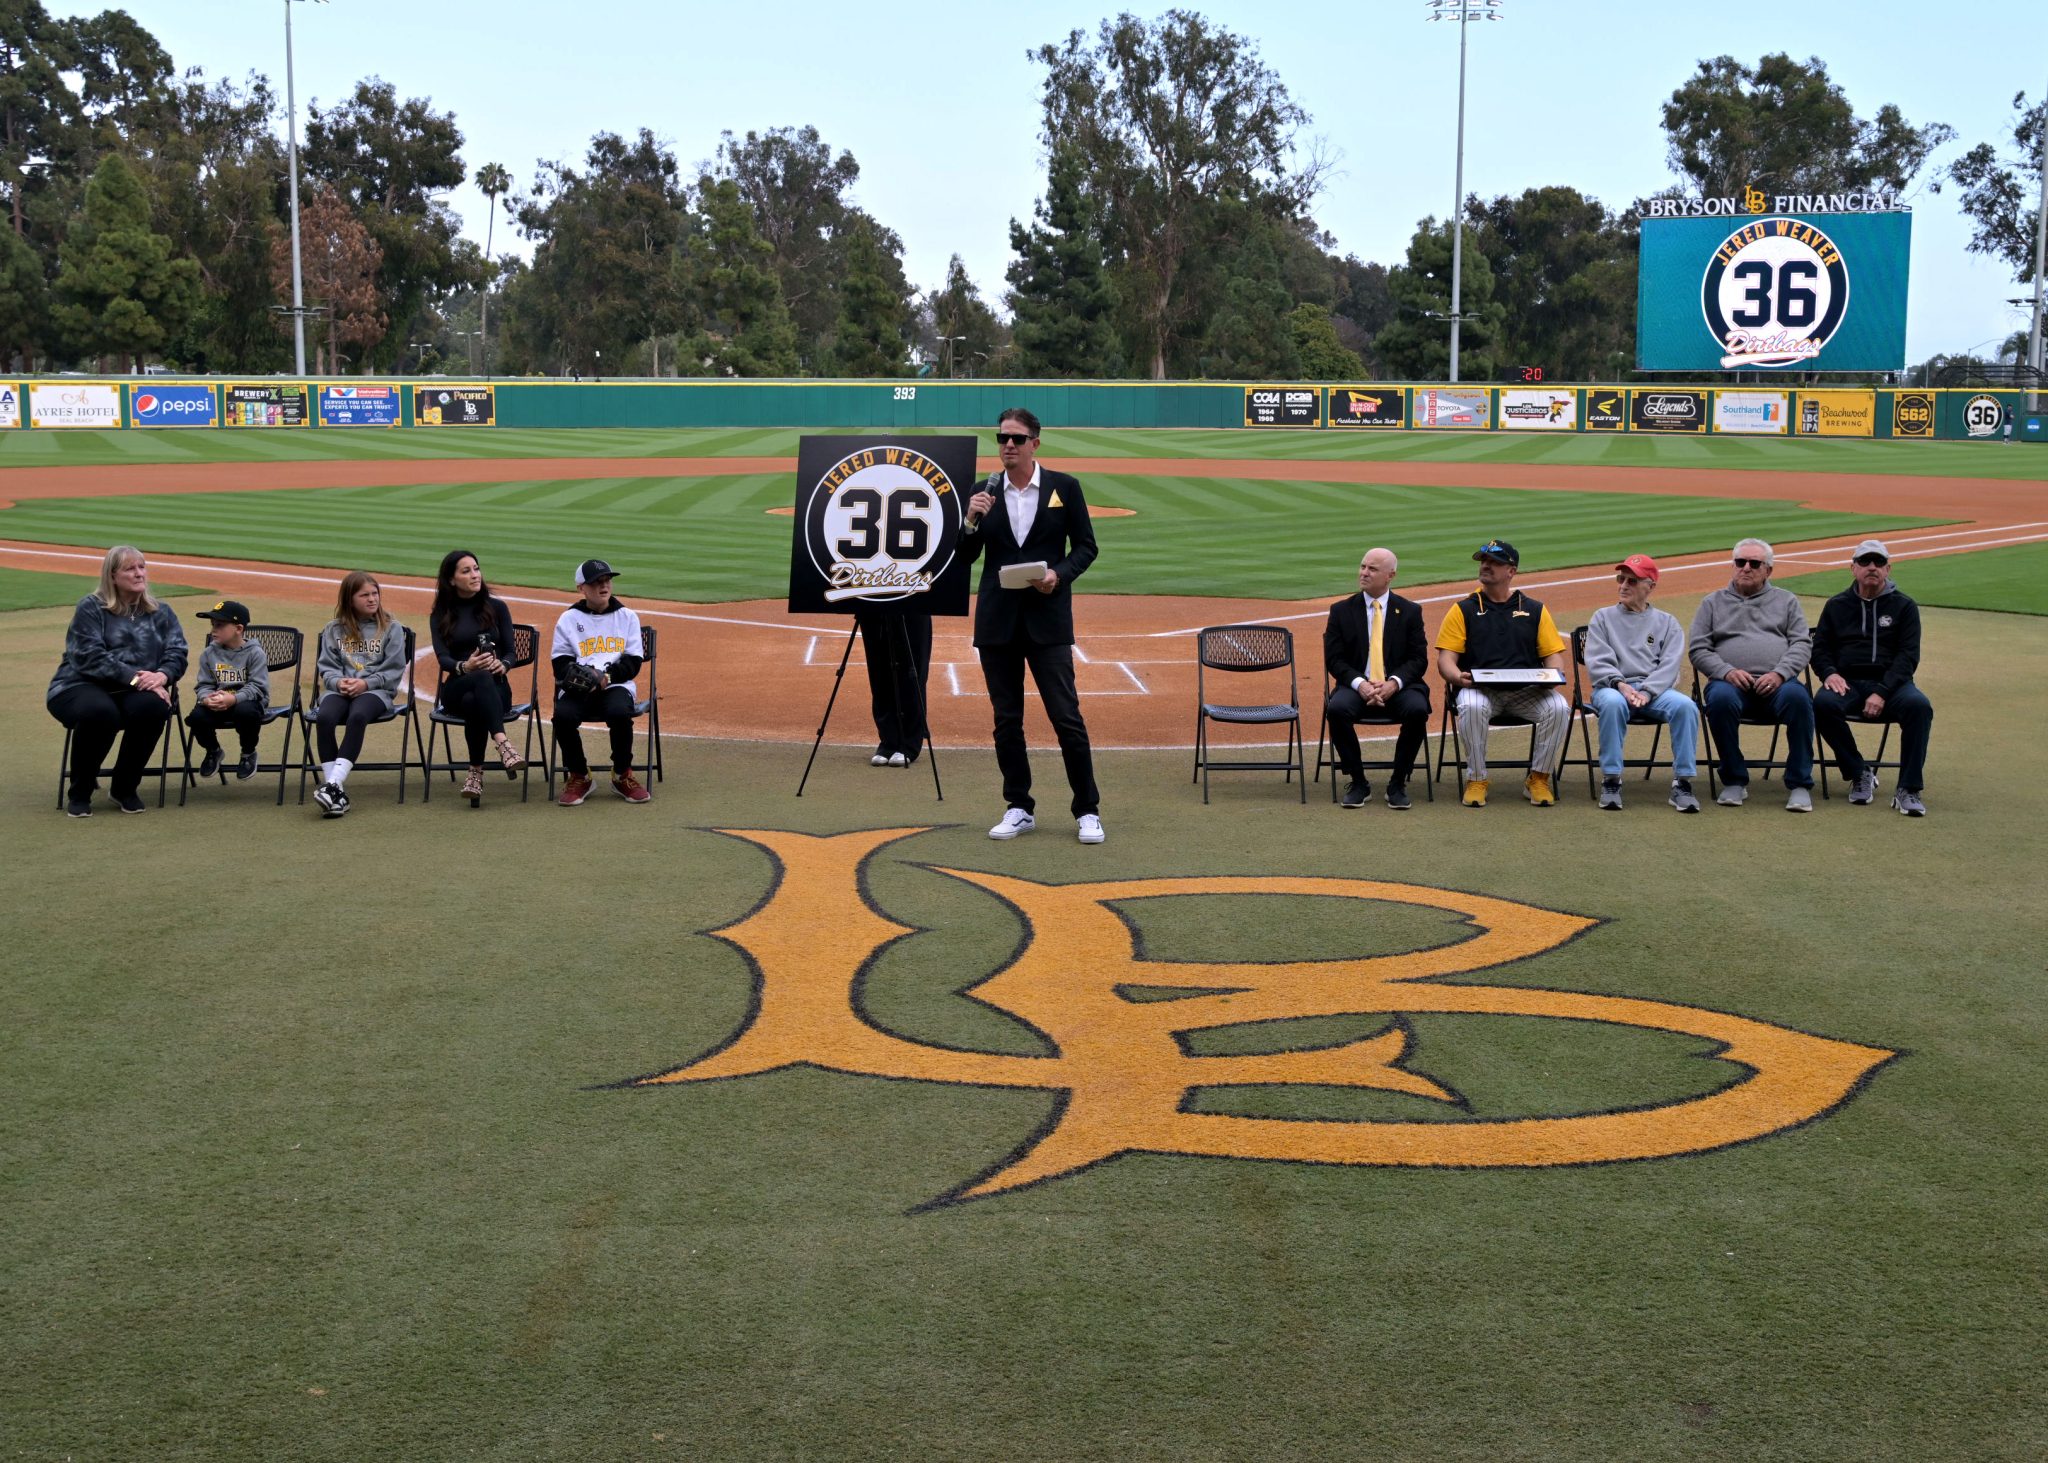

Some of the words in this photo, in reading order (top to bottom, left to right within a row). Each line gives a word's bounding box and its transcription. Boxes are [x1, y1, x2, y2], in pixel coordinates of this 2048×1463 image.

[1650, 197, 1736, 217] BRYSON
[1773, 192, 1903, 213] FINANCIAL
[1716, 222, 1766, 267] JERED
[1776, 220, 1840, 268] WEAVER
[1731, 259, 1819, 328] 36
[1724, 329, 1822, 360] Dirtbags
[234, 389, 270, 397] BREWERY
[893, 386, 916, 400] 393
[35, 407, 73, 417] AYRES
[78, 407, 118, 417] HOTEL
[162, 397, 209, 415] pepsi
[1647, 397, 1690, 415] Legends
[1722, 405, 1762, 414] Southland
[1821, 405, 1868, 418] Beachwood
[1900, 407, 1928, 421] 562
[1971, 405, 1995, 425] 36
[823, 450, 875, 494] JERED
[885, 448, 952, 497] WEAVER
[836, 488, 931, 561] 36
[829, 561, 933, 595] Dirtbags
